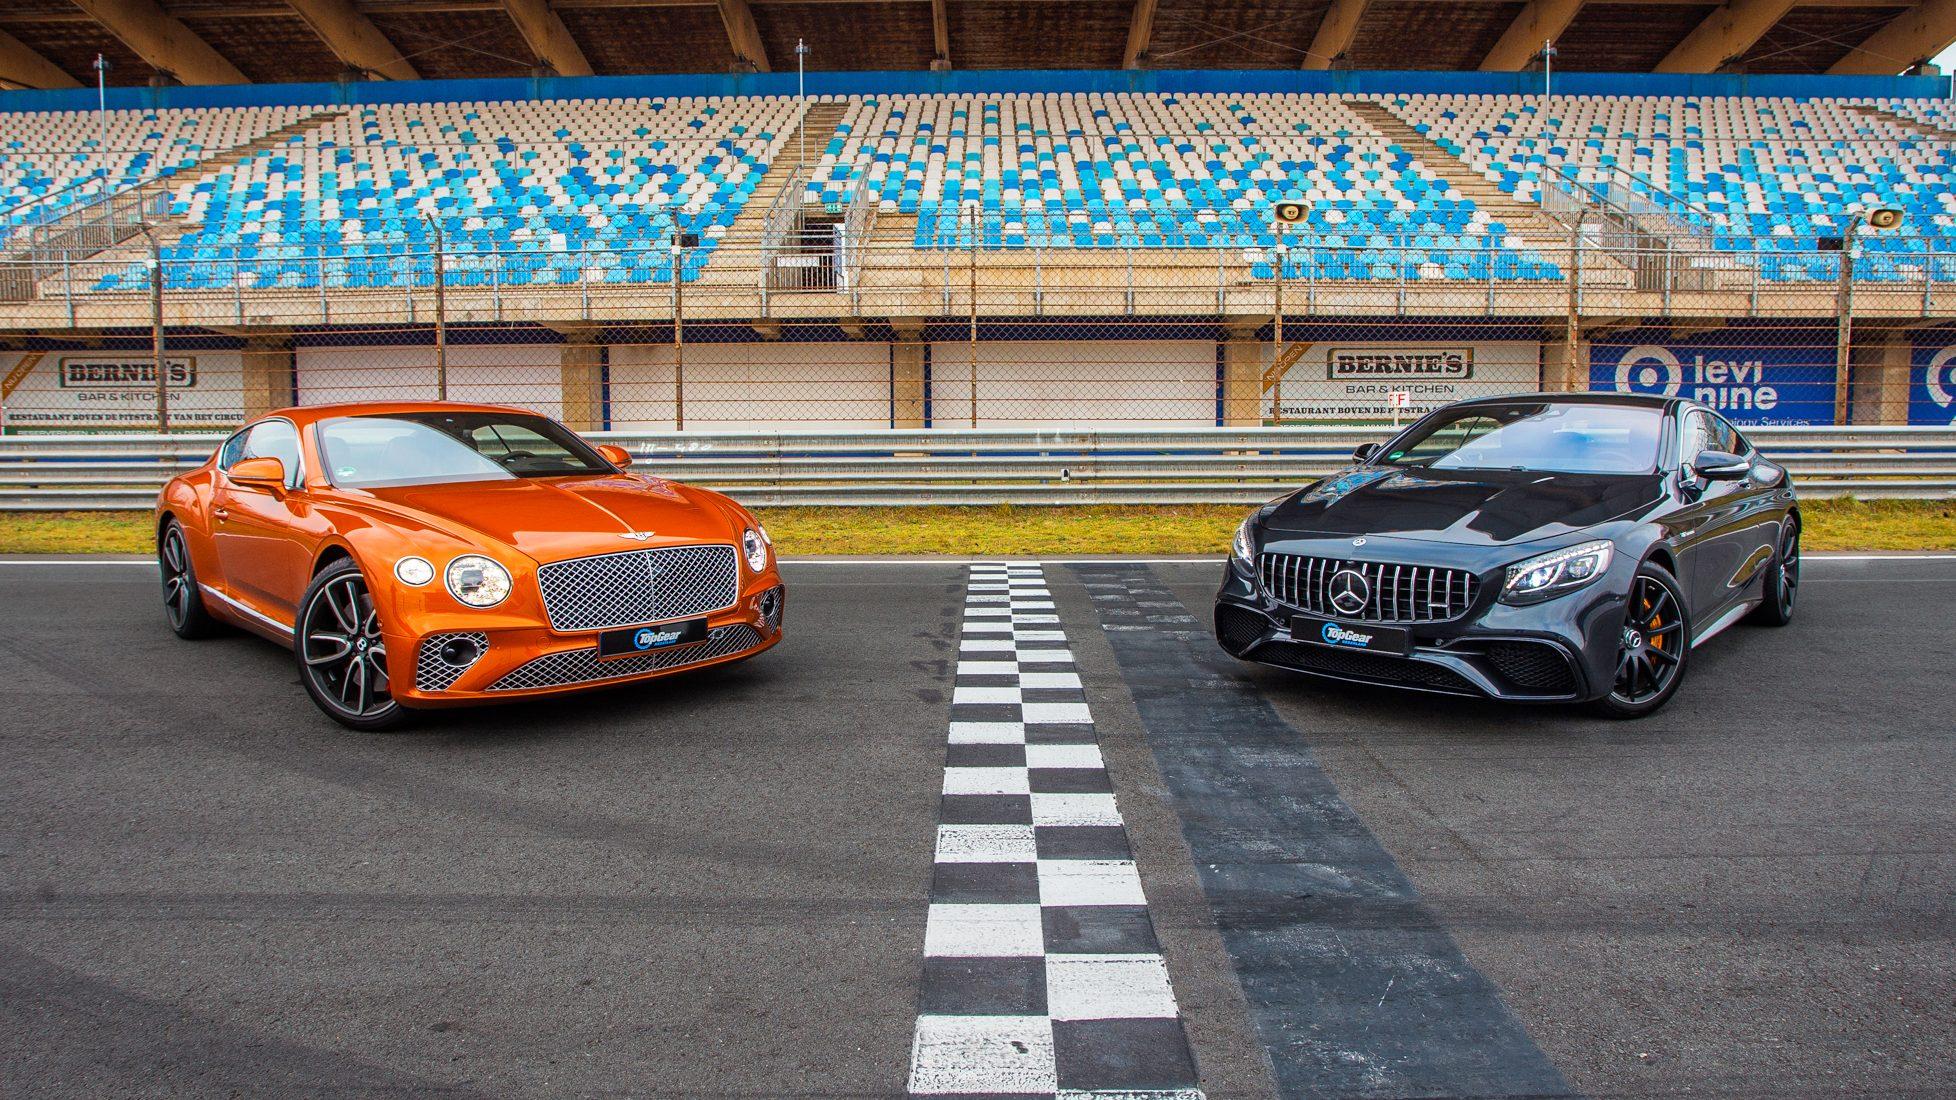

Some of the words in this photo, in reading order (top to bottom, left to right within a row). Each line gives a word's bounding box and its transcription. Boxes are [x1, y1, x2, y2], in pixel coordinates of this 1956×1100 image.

[1280, 345, 1303, 369] OPEN
[1337, 352, 1462, 373] BERNIE'S
[1694, 355, 1763, 385] levi
[1346, 386, 1375, 394] BAR
[1393, 385, 1454, 393] KITCHEN
[1694, 386, 1778, 410] nine
[1398, 393, 1407, 405] F
[639, 631, 681, 645] TopGear
[1327, 627, 1373, 643] TopGear
